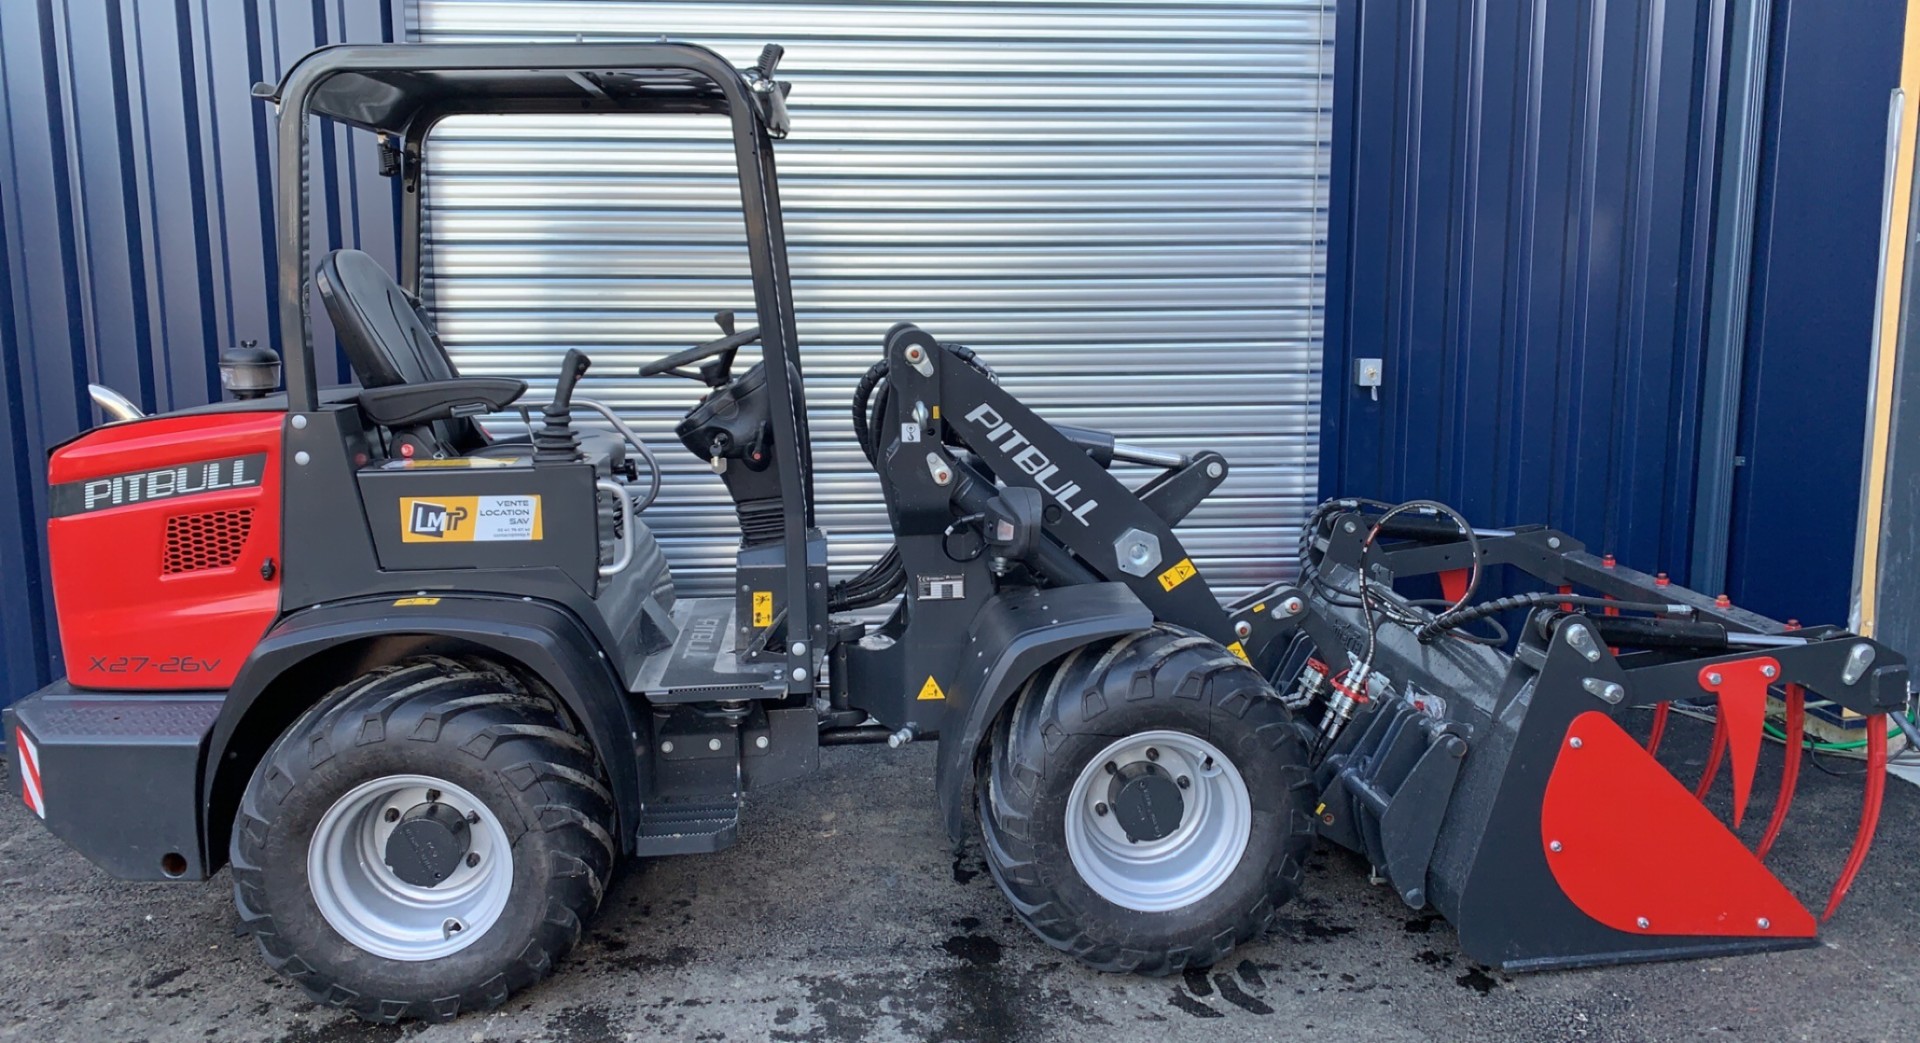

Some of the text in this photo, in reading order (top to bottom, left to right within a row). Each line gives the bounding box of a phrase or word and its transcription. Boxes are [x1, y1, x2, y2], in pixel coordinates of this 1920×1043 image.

[964, 402, 1099, 527] PITBULL
[84, 459, 256, 509] PITBULL
[496, 499, 529, 507] VENTE
[479, 509, 530, 517] LOCATION
[509, 517, 530, 525] SAV
